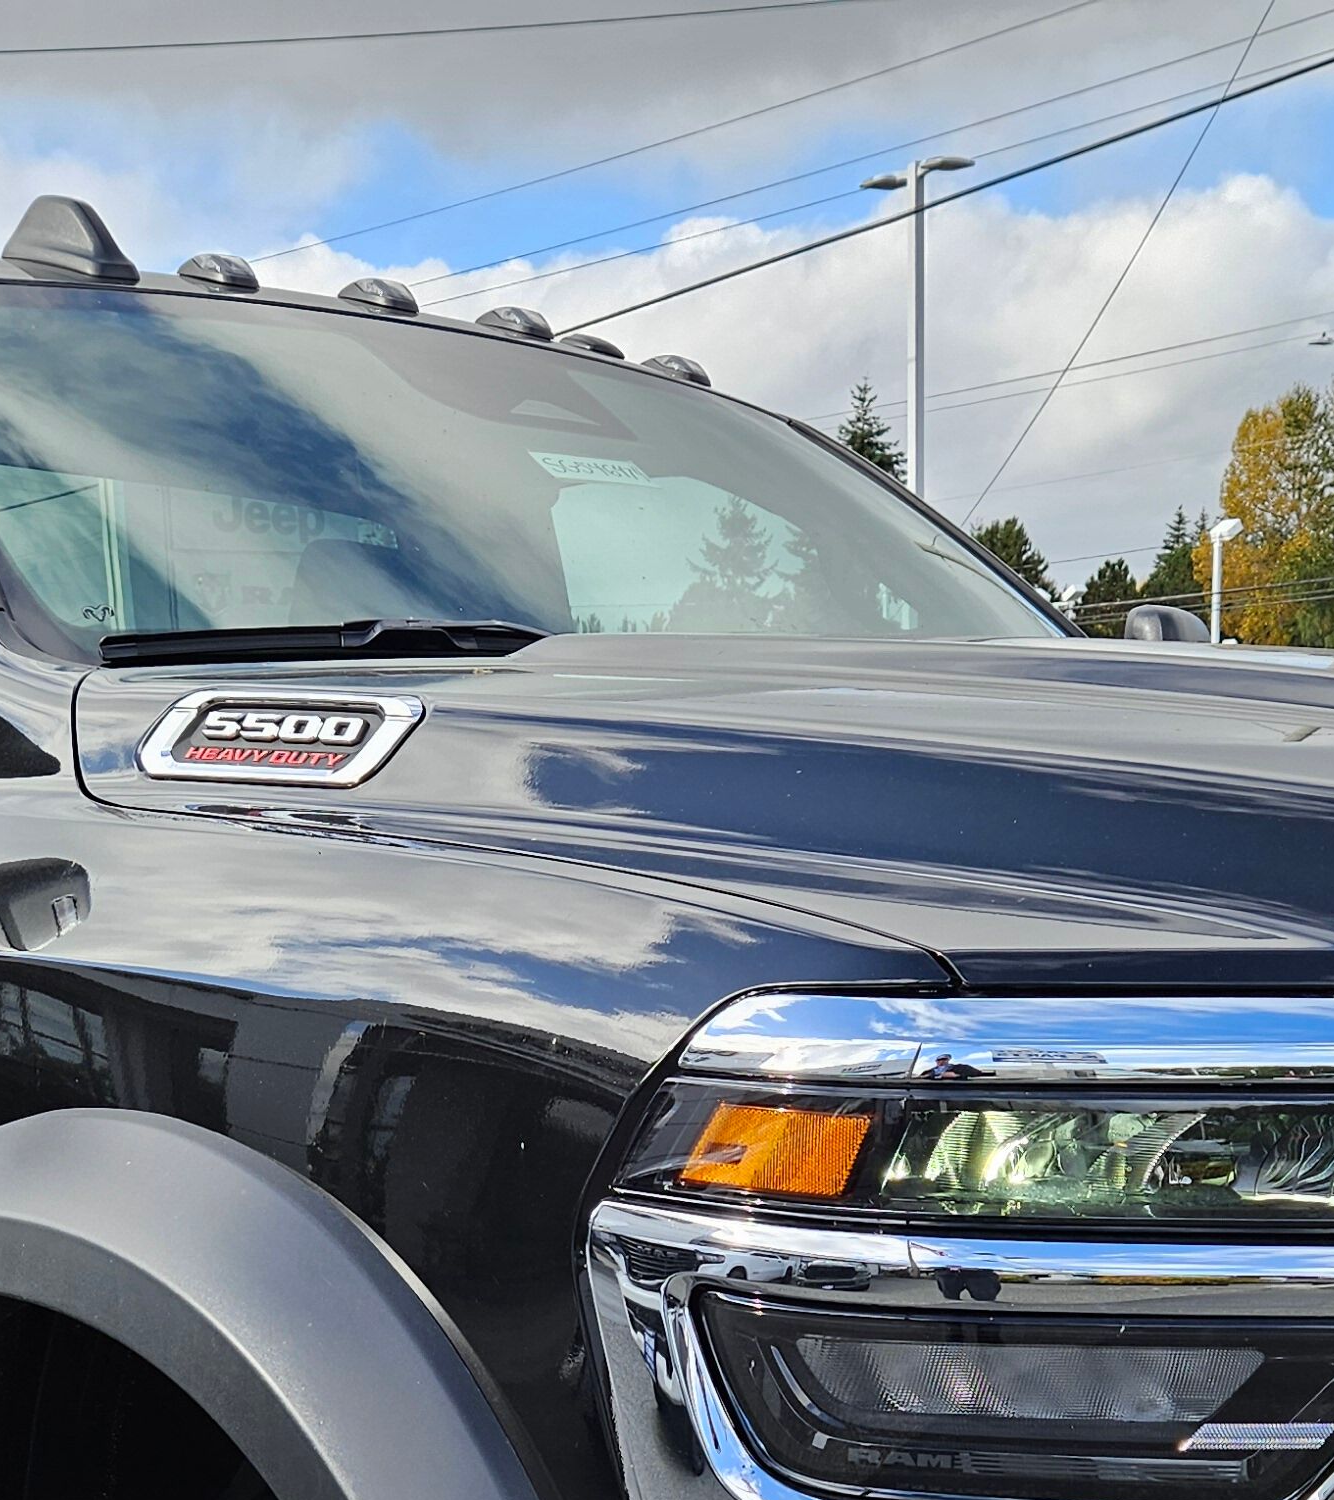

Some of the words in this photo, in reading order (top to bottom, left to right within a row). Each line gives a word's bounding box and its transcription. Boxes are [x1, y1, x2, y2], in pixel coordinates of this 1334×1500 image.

[212, 495, 325, 544] Jeep
[201, 711, 366, 745] 5500
[184, 747, 269, 764] HEAVY
[269, 751, 349, 768] DUTY
[847, 1447, 953, 1469] RAM
